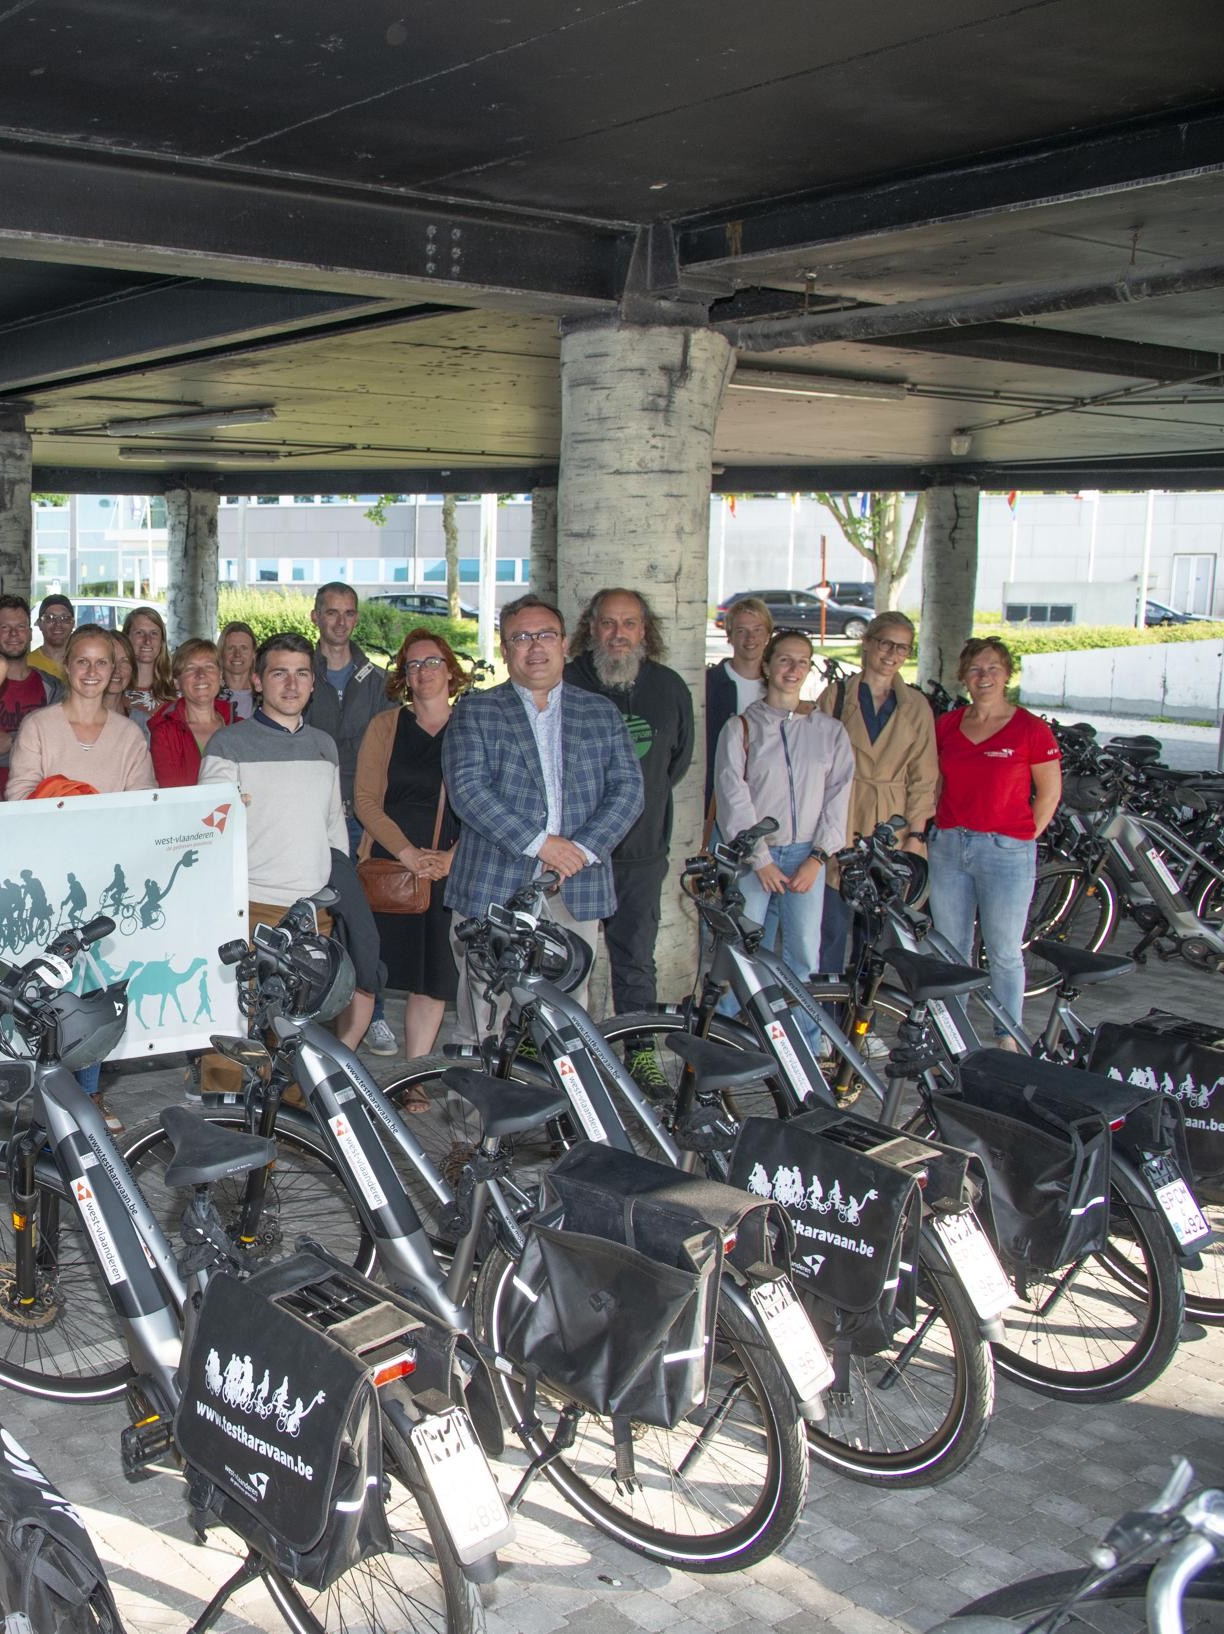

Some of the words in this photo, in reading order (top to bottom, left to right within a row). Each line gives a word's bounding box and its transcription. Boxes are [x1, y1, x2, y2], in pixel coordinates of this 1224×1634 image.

[154, 831, 214, 846] west-vlaanderen
[345, 1061, 399, 1136] www.testkaravaan.be
[87, 1132, 138, 1216] www.testkaravaan.be
[345, 1136, 384, 1207] west-vlaanderen
[86, 1201, 121, 1282] west-vlaanderen
[195, 1399, 314, 1481] www.testkaravaan.be
